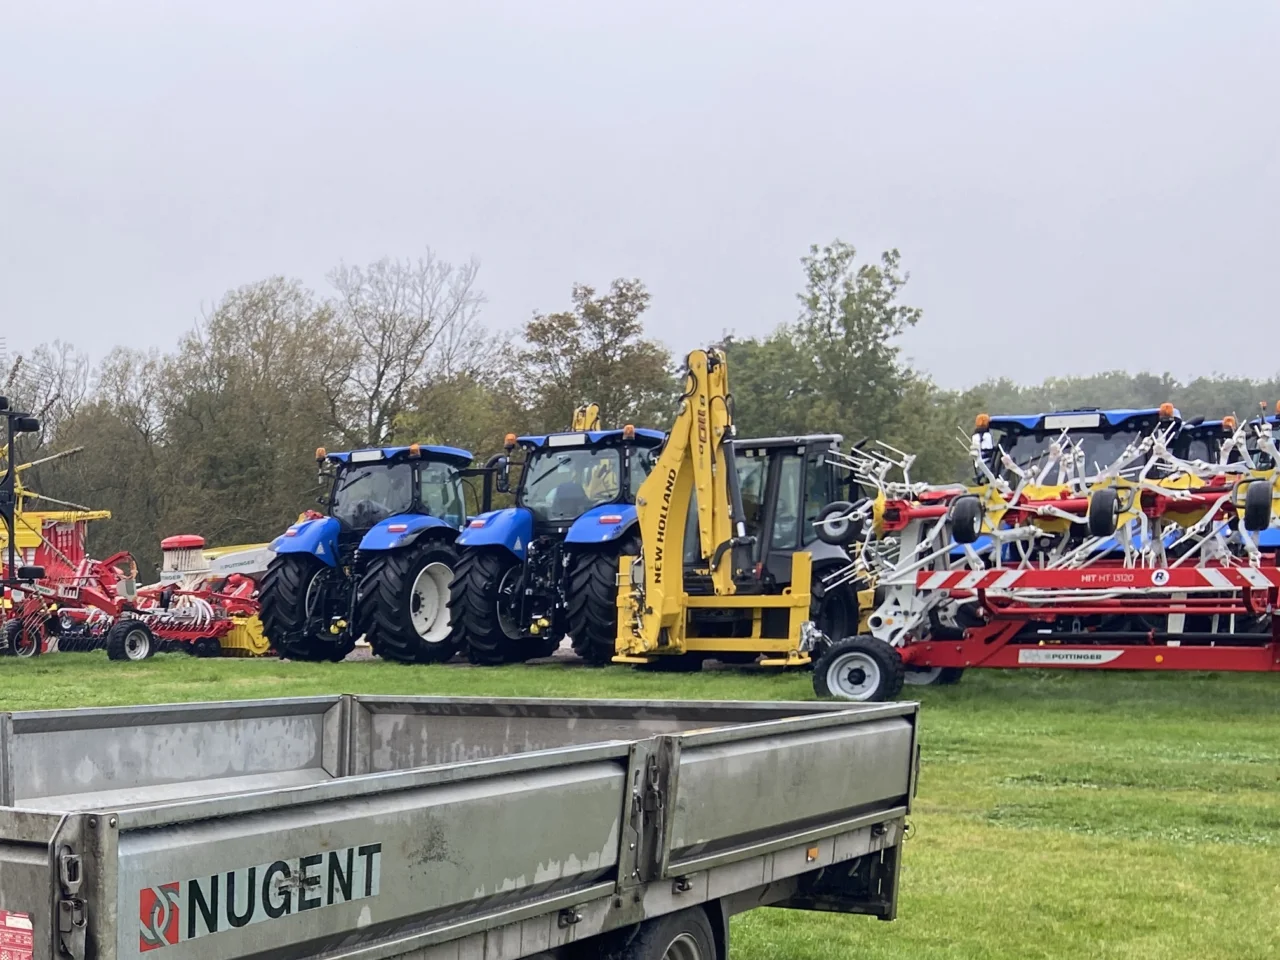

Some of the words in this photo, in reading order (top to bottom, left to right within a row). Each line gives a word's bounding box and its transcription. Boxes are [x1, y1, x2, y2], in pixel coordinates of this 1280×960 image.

[656, 468, 677, 543] HOLLAND
[654, 546, 663, 584] NEW
[1081, 574, 1097, 582] HIT
[1098, 574, 1111, 582] HT
[1113, 573, 1134, 582] 13120
[187, 842, 382, 940] NUGENT
